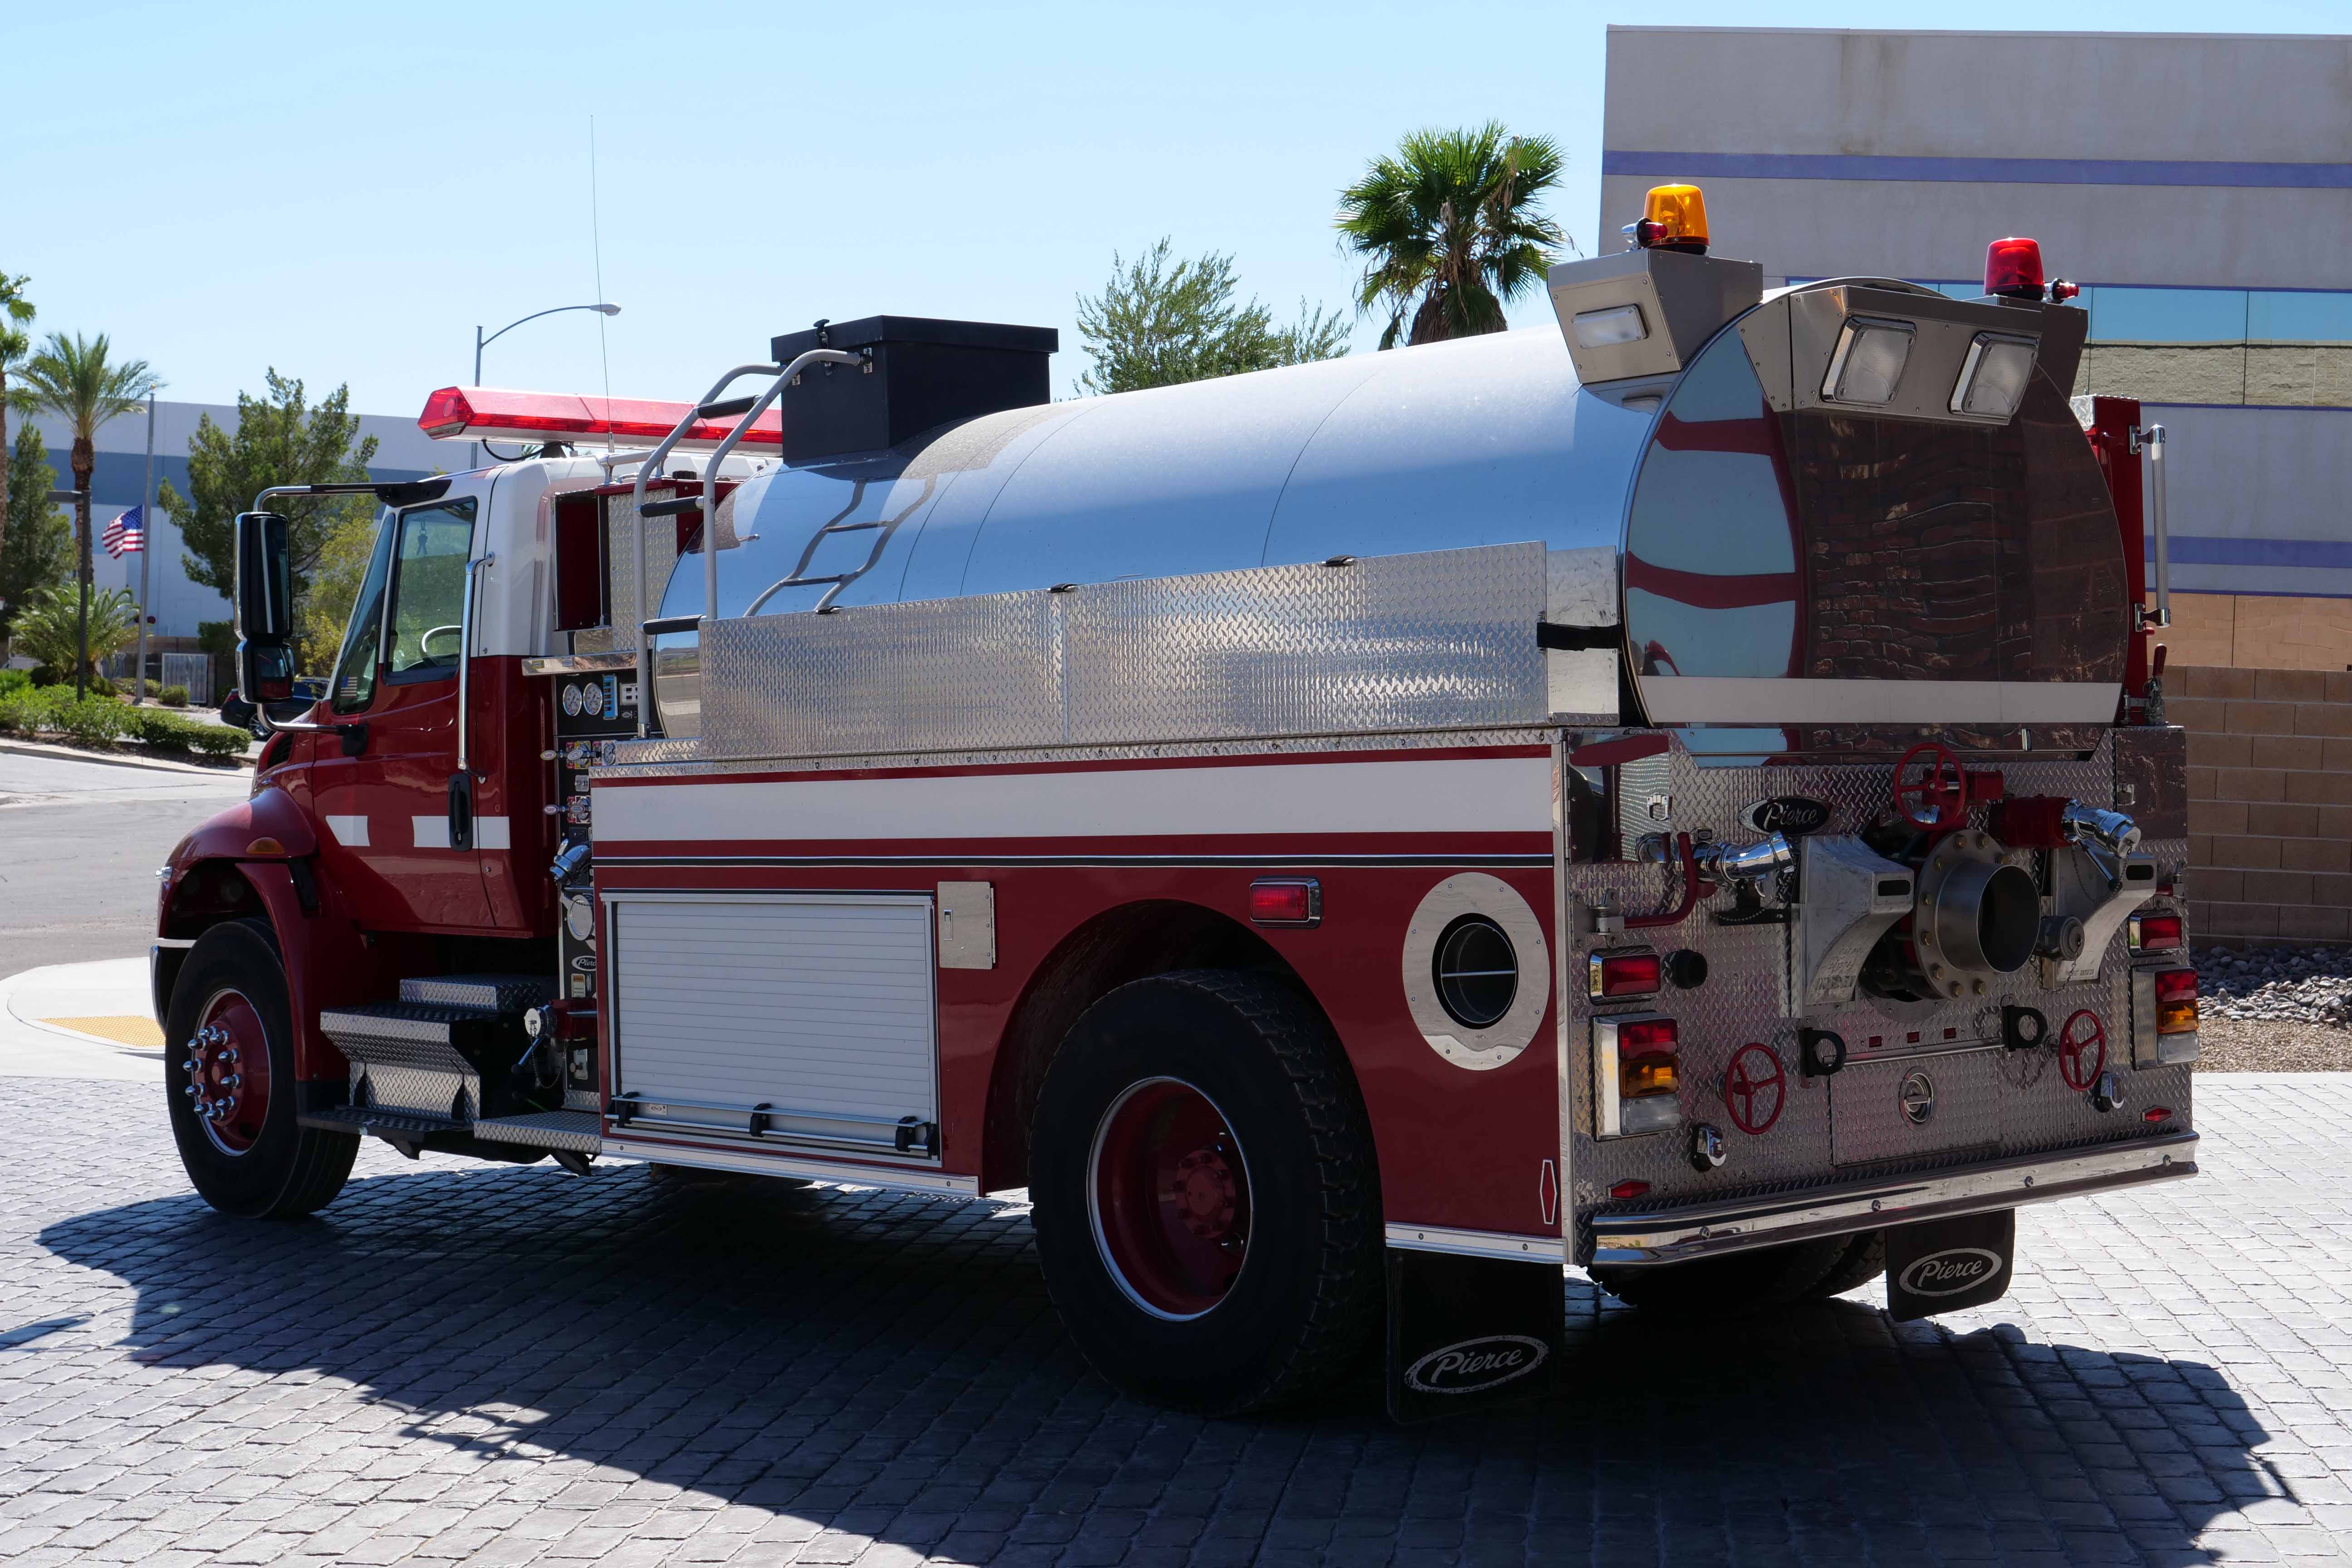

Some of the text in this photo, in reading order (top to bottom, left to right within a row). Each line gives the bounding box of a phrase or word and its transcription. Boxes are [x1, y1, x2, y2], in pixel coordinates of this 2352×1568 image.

[1764, 802, 1818, 829] Pierce
[1917, 1260, 1982, 1287] Pierce
[1431, 1349, 1523, 1383] Pierce
